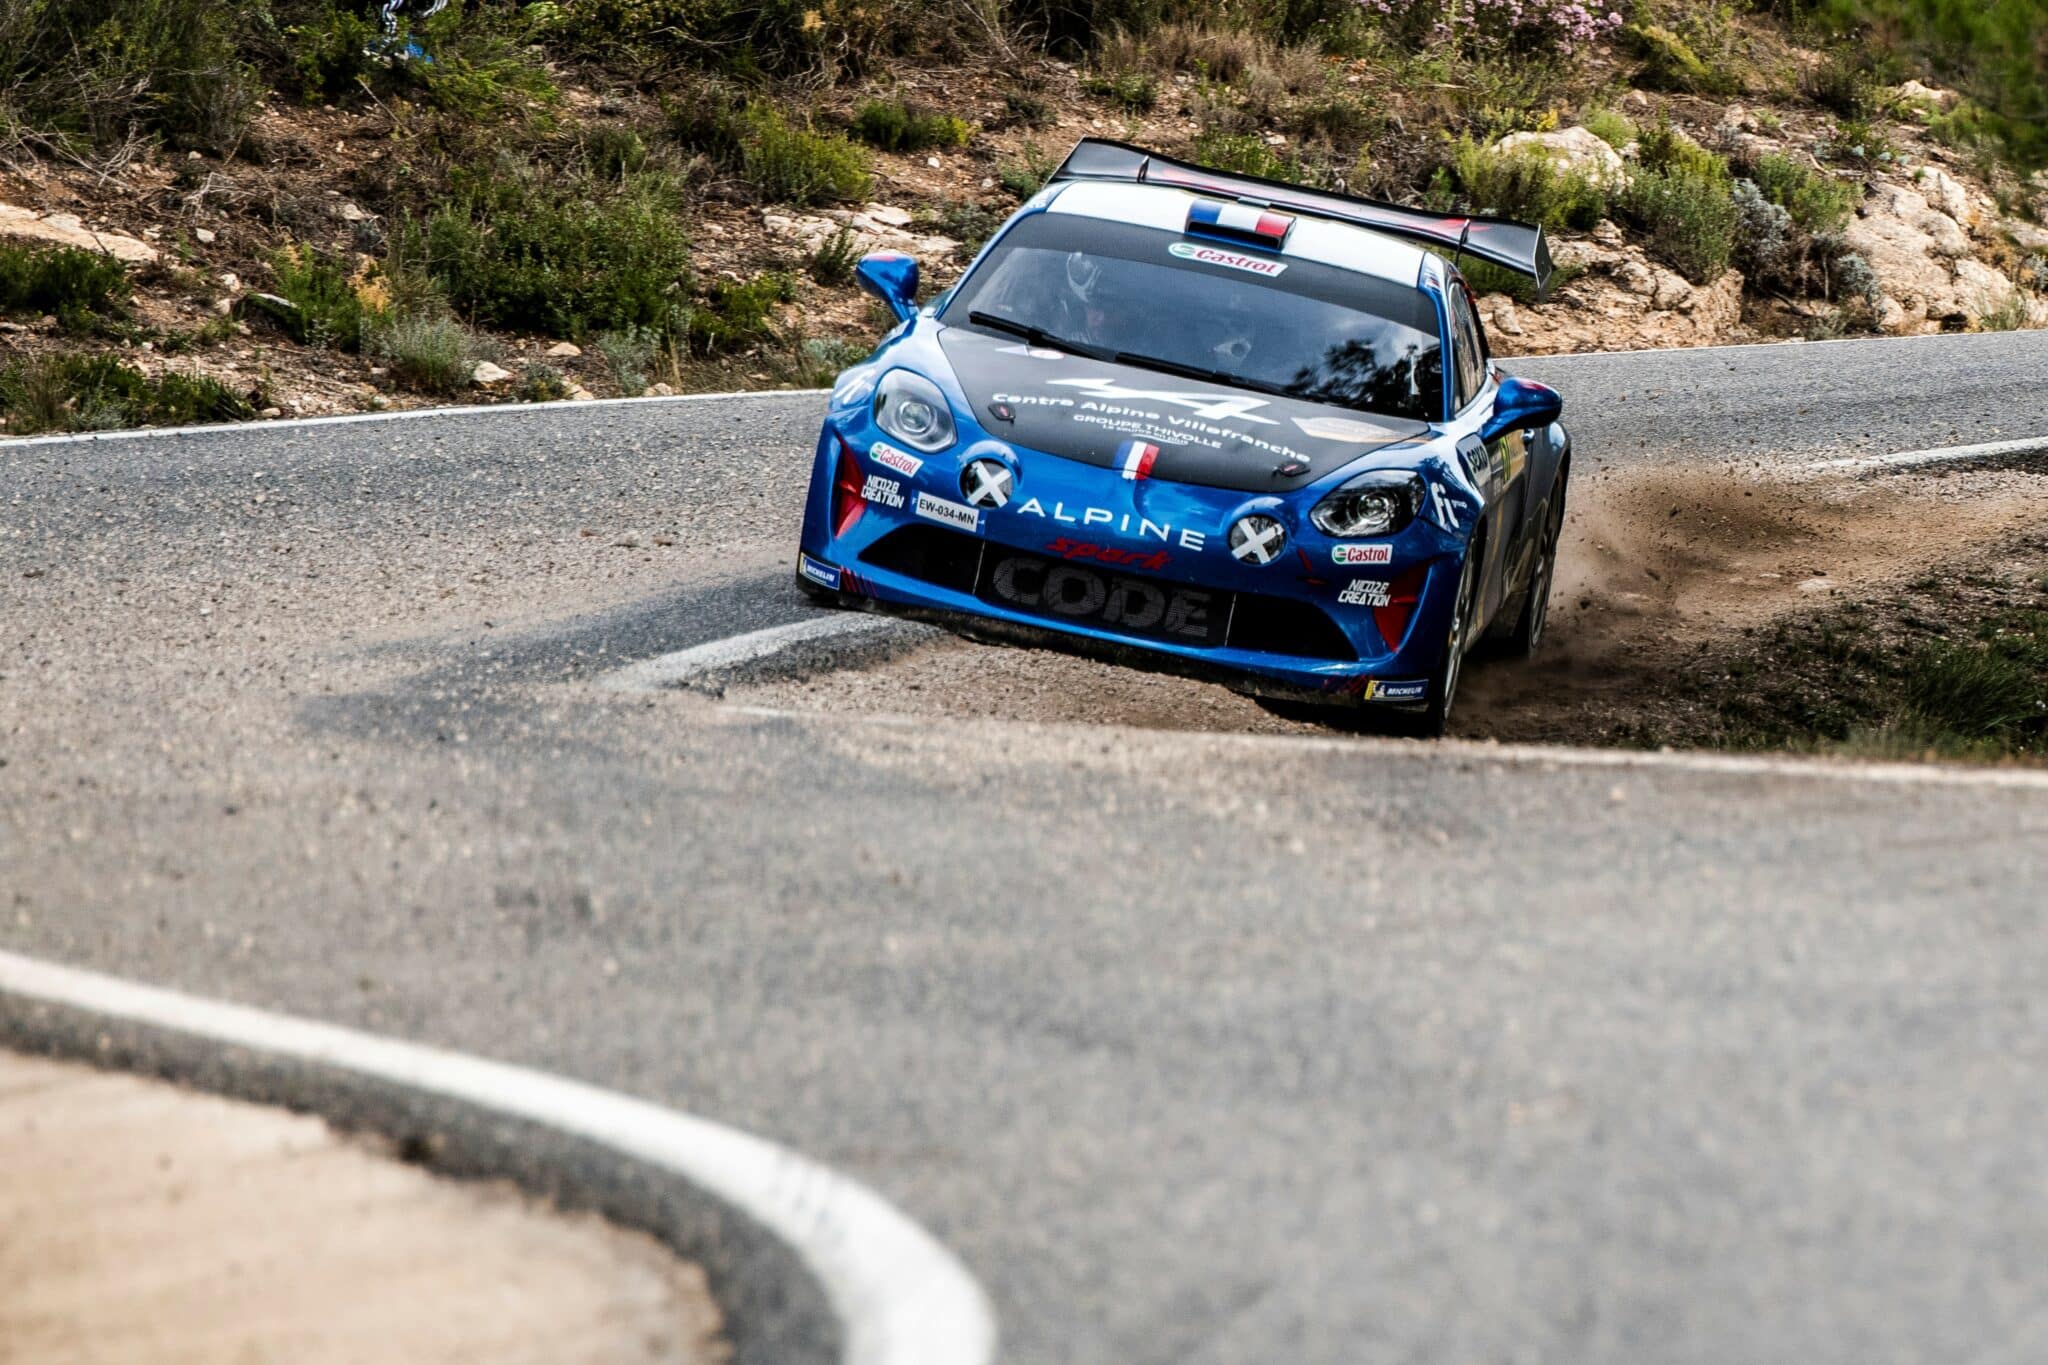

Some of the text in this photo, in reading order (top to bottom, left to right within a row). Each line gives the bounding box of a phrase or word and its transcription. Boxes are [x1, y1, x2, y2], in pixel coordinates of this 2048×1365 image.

[1196, 249, 1278, 274] Castrol
[992, 393, 1311, 463] Centre Alpine Villefranche
[1073, 414, 1223, 449] GROUPE THIVOLLE
[880, 448, 918, 475] Castrol
[861, 485, 905, 509] CREATION
[919, 498, 975, 526] EW-034-MN
[1017, 497, 1206, 552] ALPINE
[1045, 537, 1174, 570] sport
[1347, 546, 1389, 562] Castrol
[993, 557, 1209, 637] CODE
[1338, 589, 1392, 608] CREATION
[1386, 686, 1424, 696] MICHELIN
